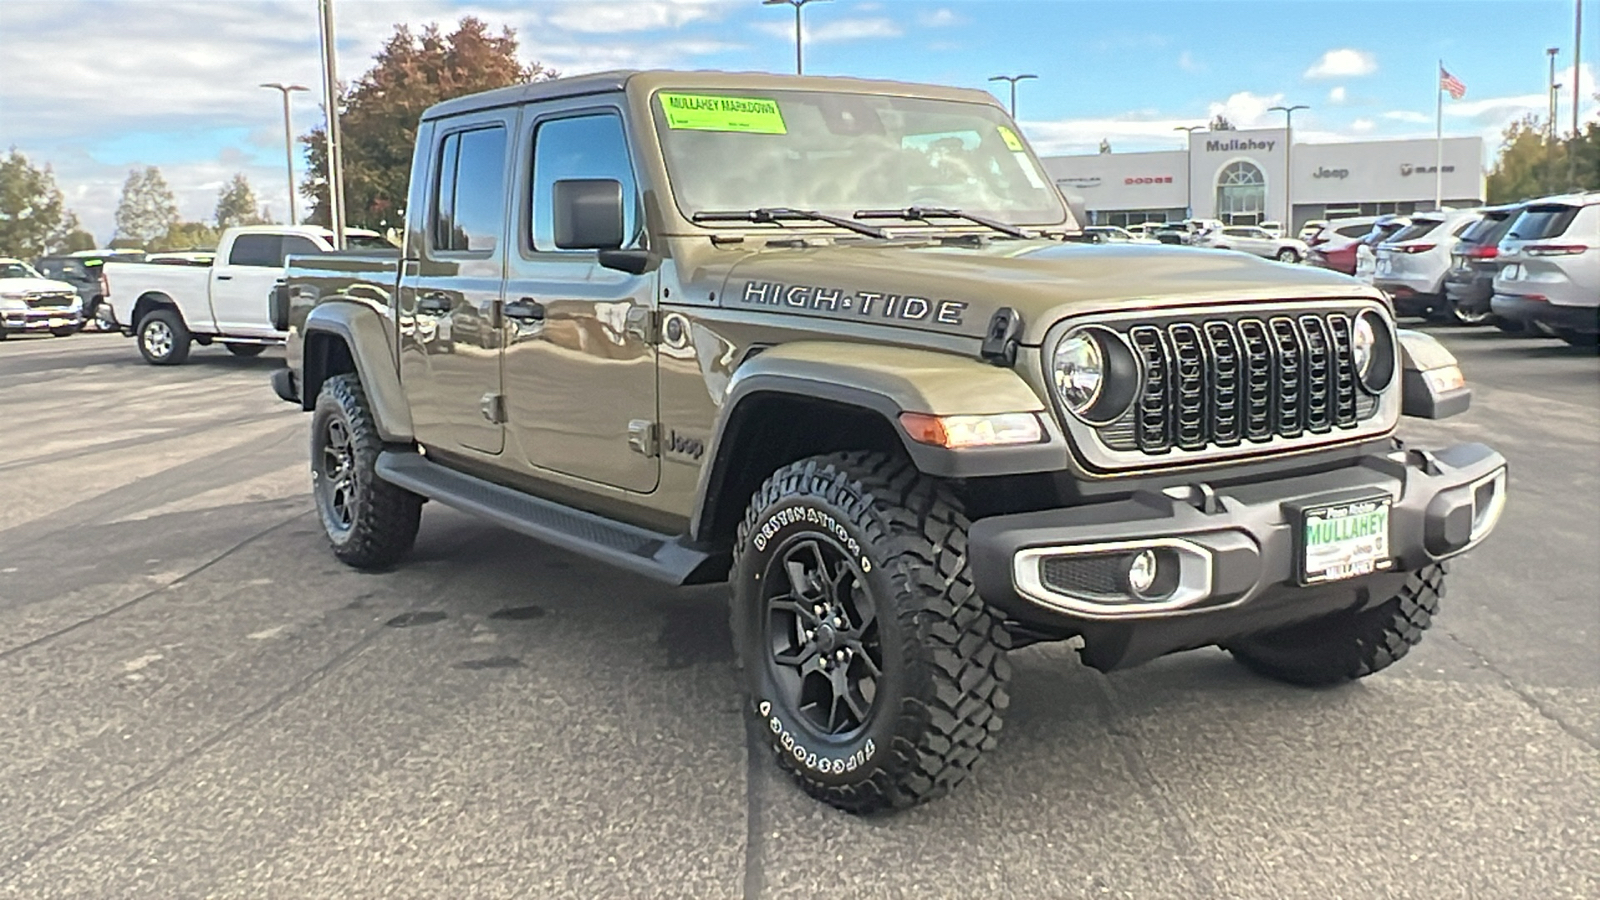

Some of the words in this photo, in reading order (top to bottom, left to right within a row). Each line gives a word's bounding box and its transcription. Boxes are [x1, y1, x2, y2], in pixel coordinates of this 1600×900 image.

[669, 96, 719, 112] MULLAHEY
[721, 99, 776, 114] MARKDOWN
[1206, 138, 1276, 152] Mullahey
[1124, 176, 1173, 186] DODGE
[1313, 166, 1349, 179] Jeep
[742, 281, 844, 312] HIGH
[855, 291, 969, 325] TIDE
[663, 429, 704, 460] Jeep
[753, 506, 861, 557] DESTINATION
[1306, 512, 1386, 546] MULLAHEY
